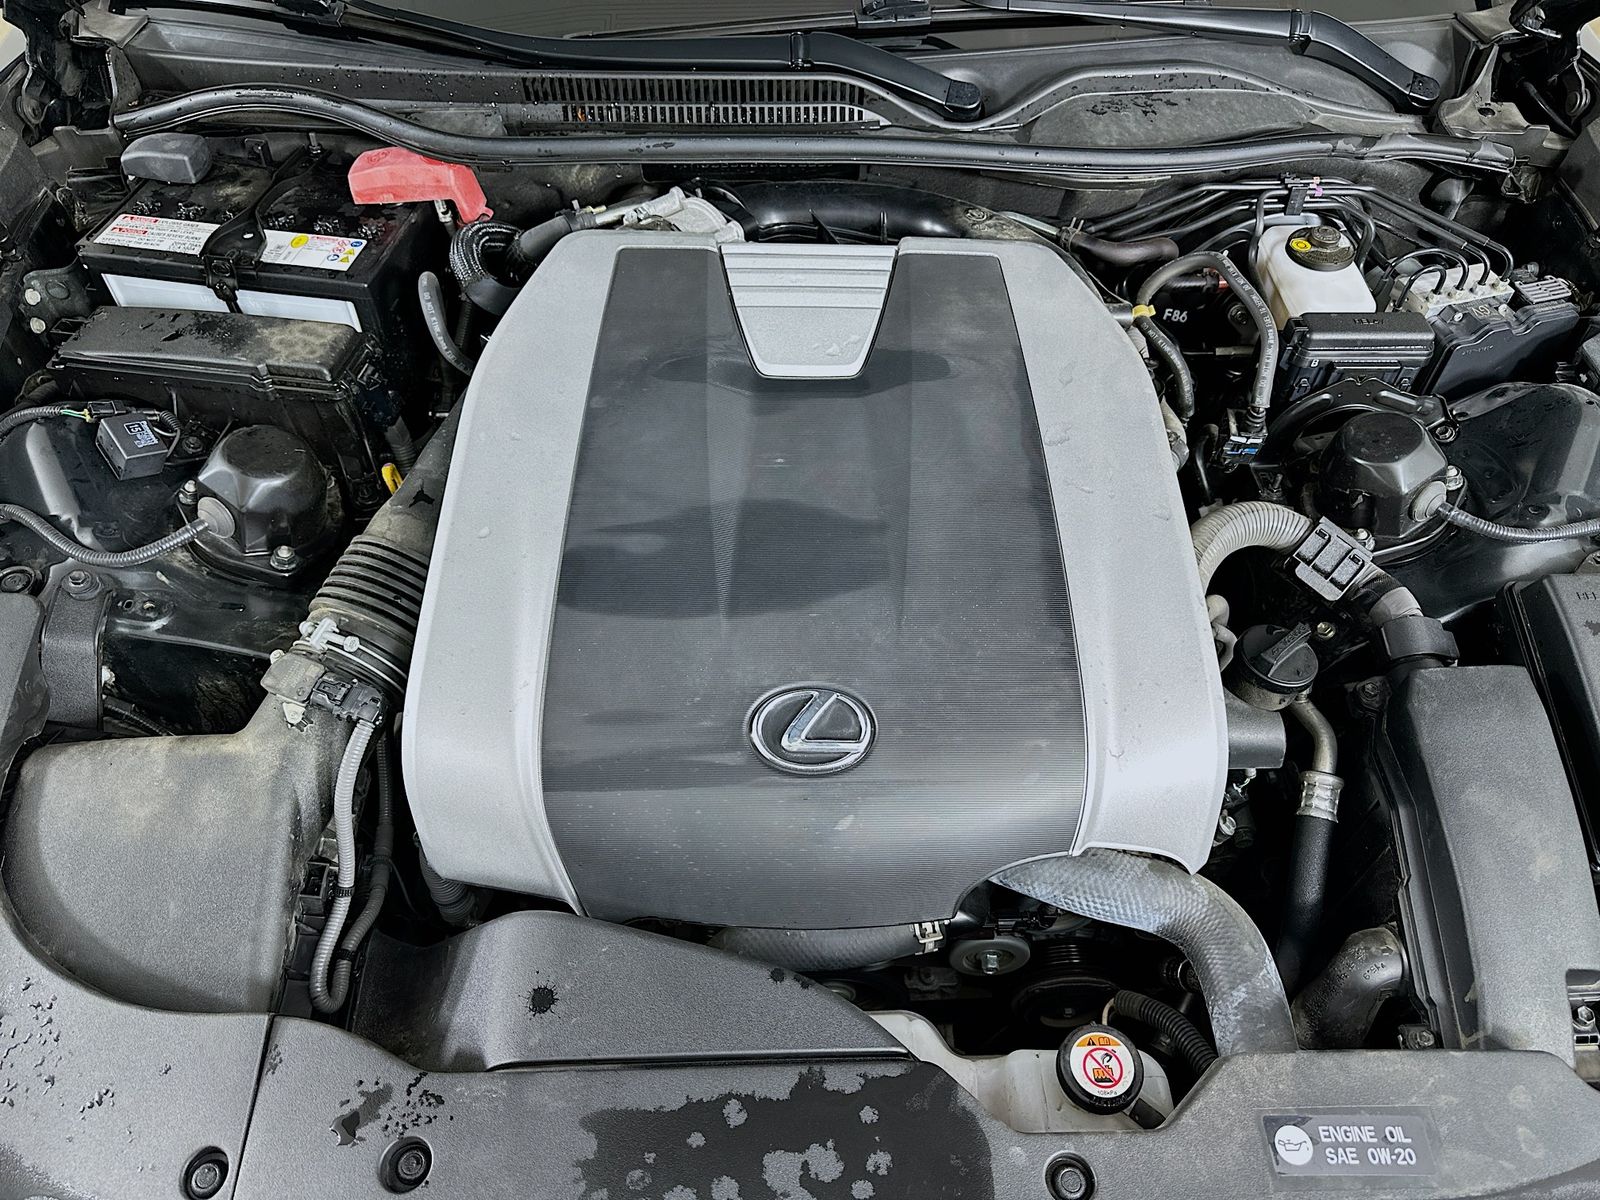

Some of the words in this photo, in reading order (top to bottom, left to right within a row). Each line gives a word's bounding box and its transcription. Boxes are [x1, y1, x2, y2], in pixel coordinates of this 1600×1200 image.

[1163, 309, 1188, 323] F86
[1318, 1126, 1378, 1143] ENGINE
[1384, 1126, 1412, 1143] OIL
[1326, 1148, 1360, 1165] SAE
[1367, 1148, 1417, 1165] 0W-20
